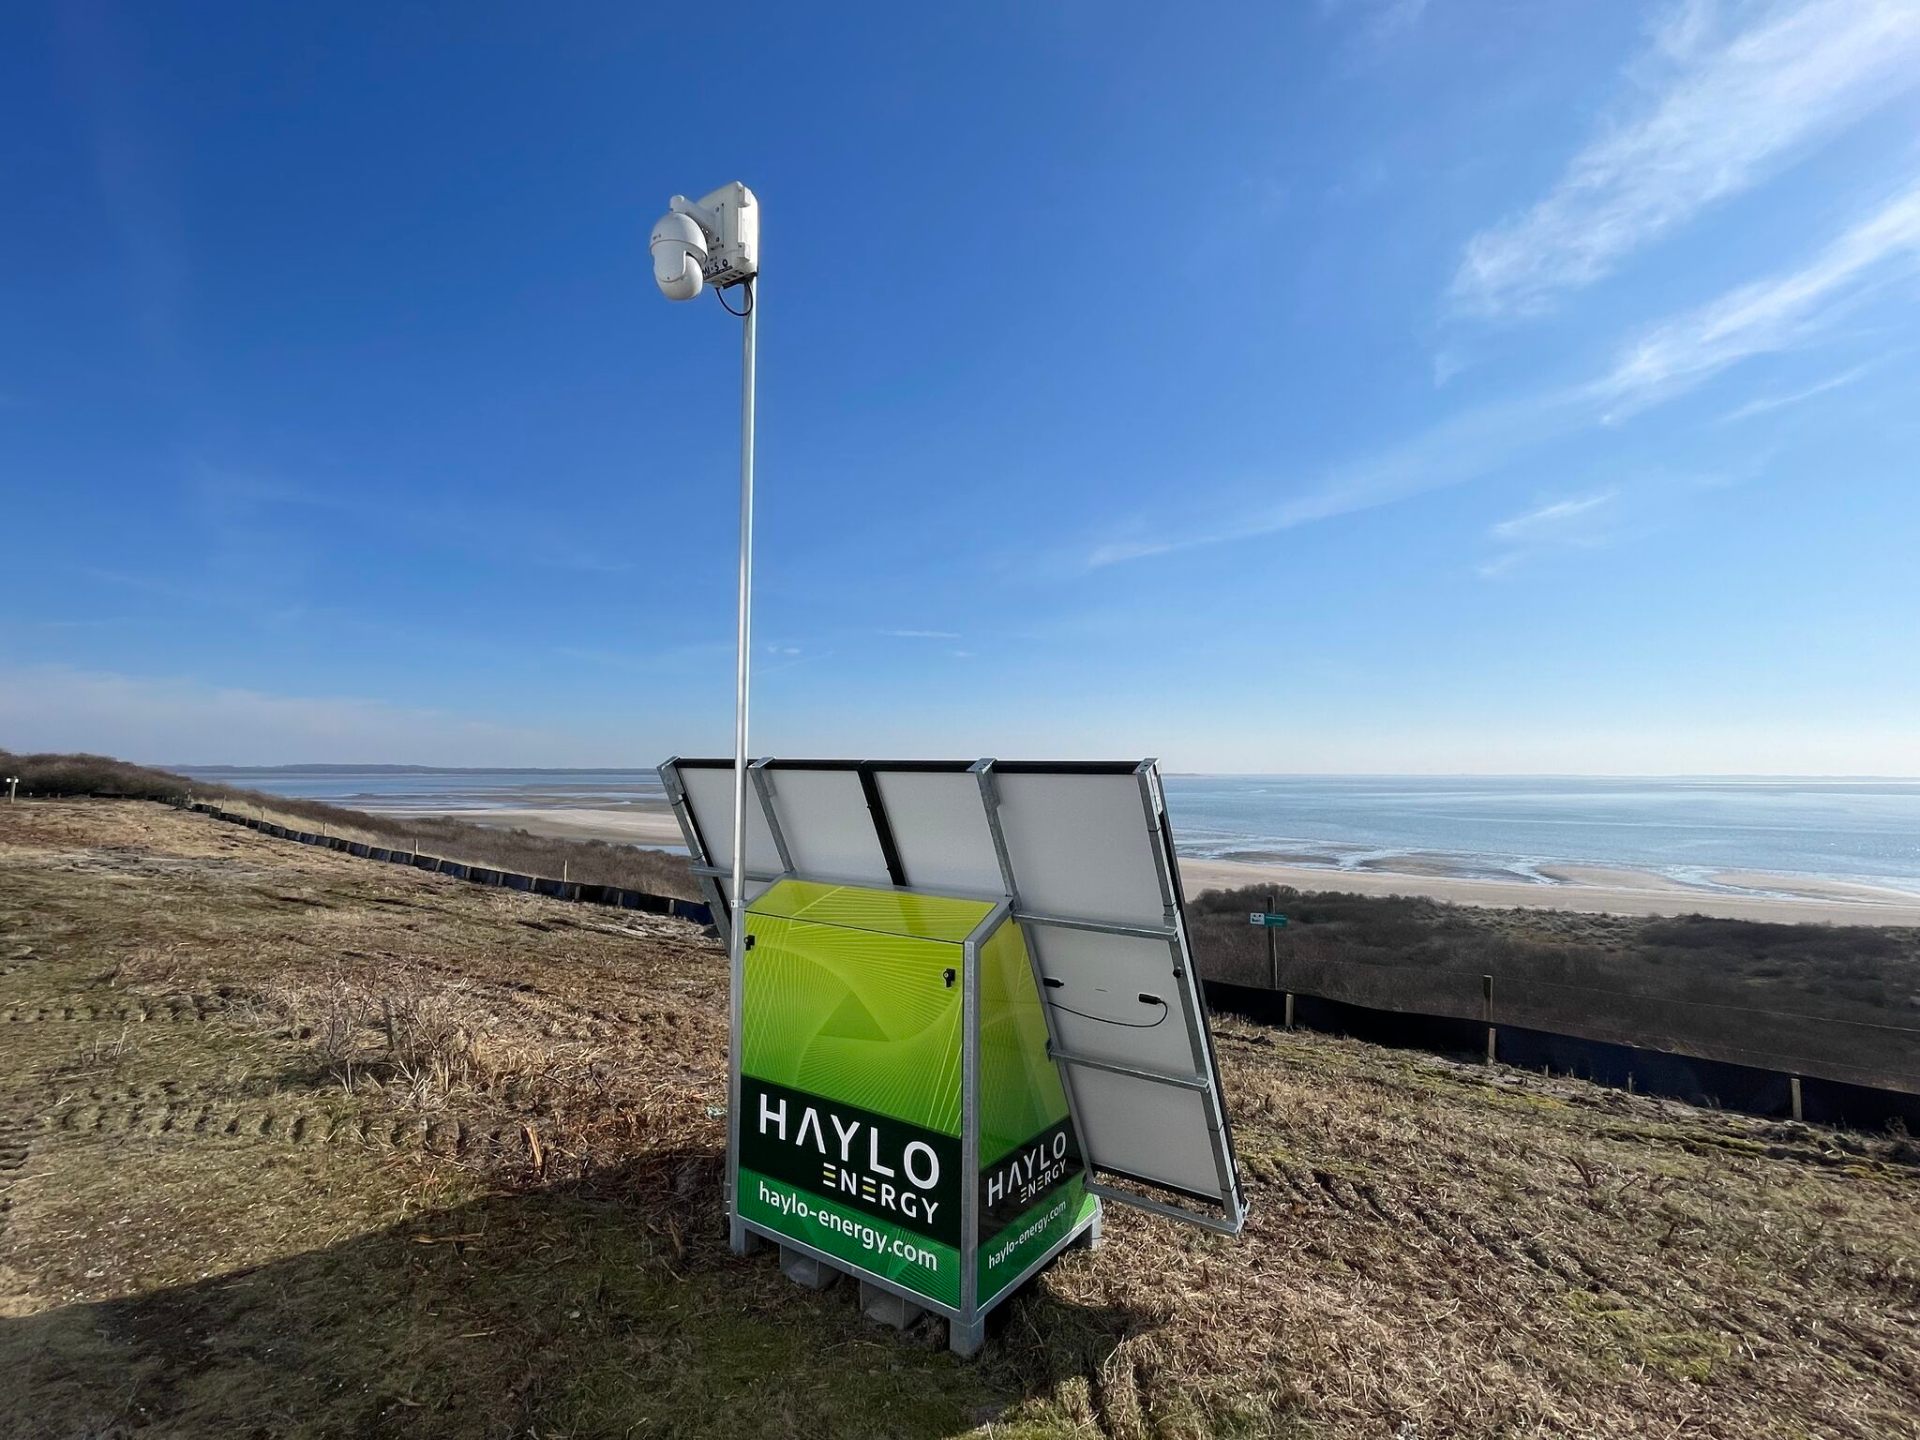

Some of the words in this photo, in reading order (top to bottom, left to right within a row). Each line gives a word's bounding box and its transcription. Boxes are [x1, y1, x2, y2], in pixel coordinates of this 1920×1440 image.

[759, 1093, 940, 1190] HAYLO
[988, 1131, 1067, 1207] HAYLO
[823, 1163, 939, 1224] ENERGY
[1020, 1159, 1067, 1204] ENERGY
[759, 1181, 938, 1271] haylo-energy.com
[988, 1200, 1067, 1270] haylo-energy.com
